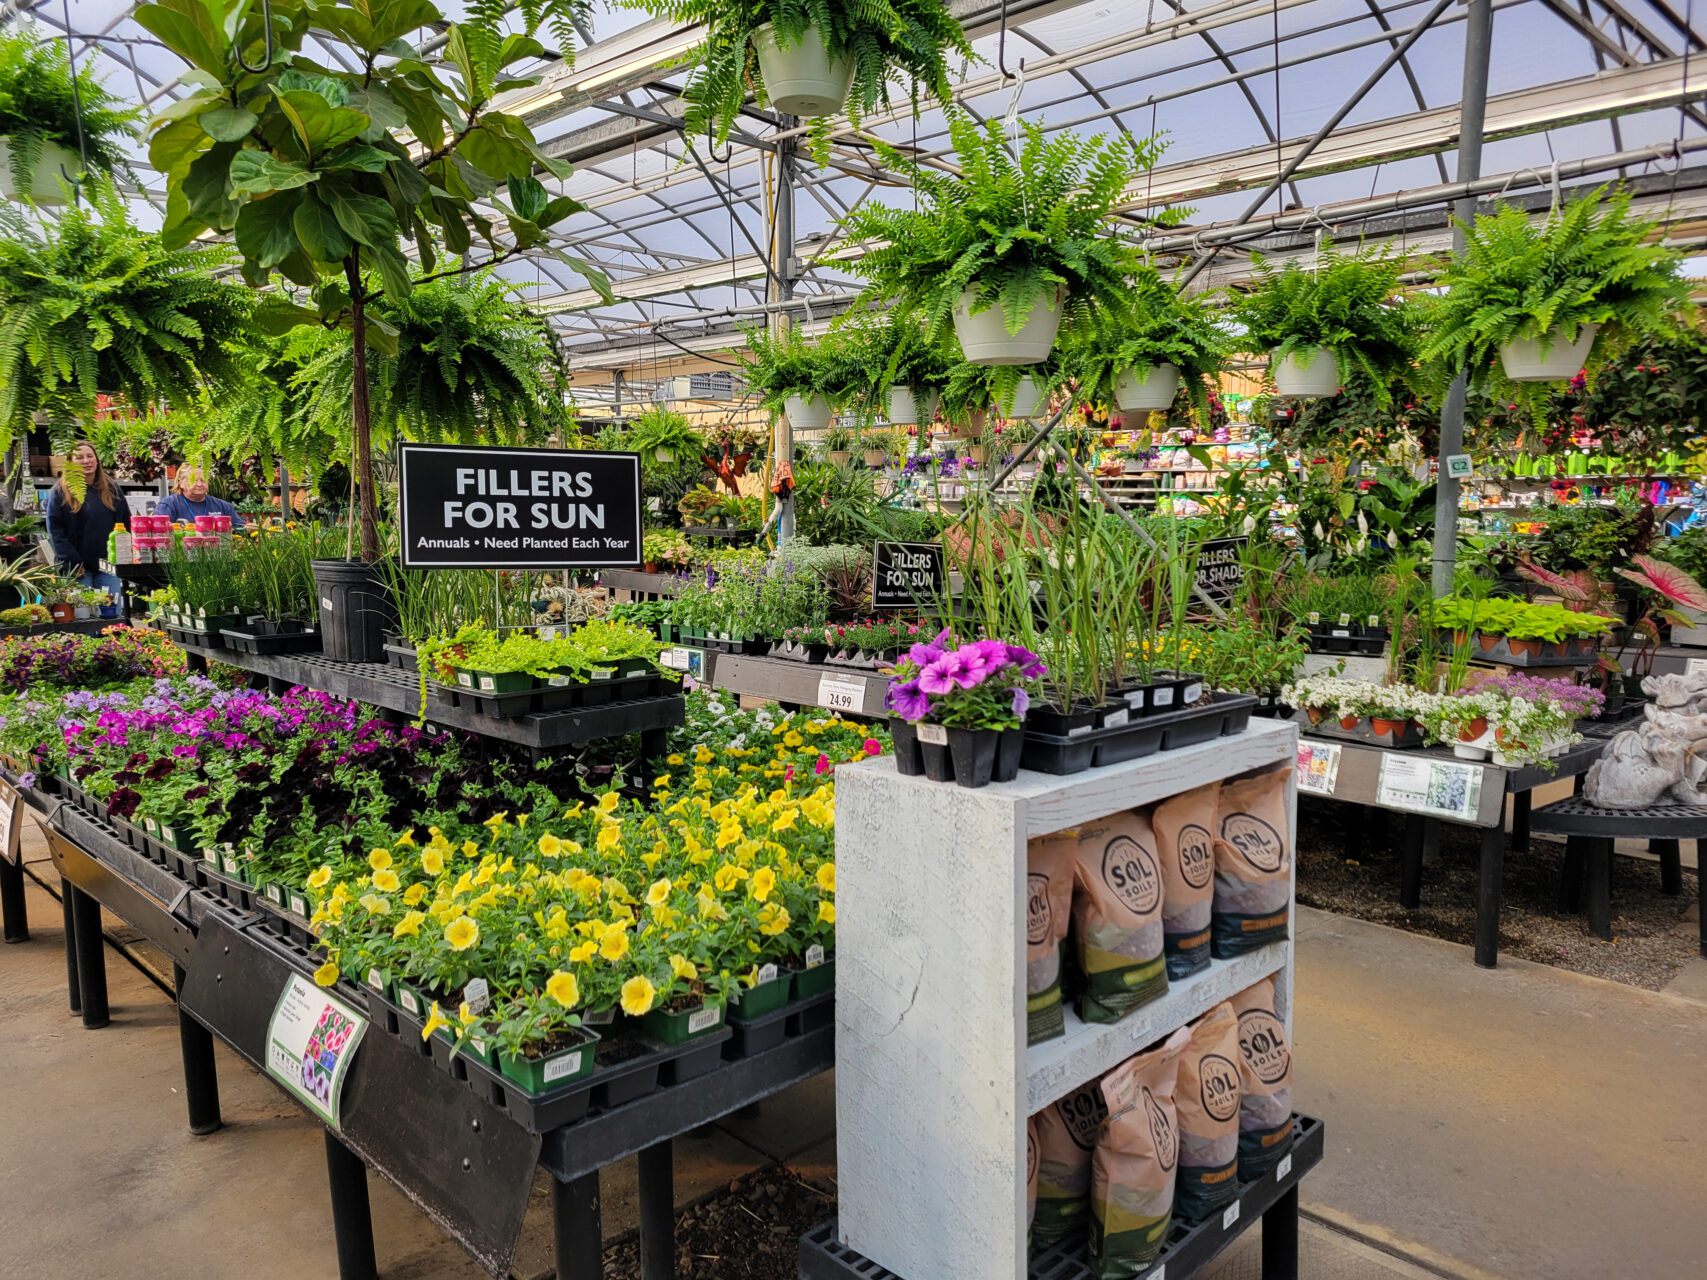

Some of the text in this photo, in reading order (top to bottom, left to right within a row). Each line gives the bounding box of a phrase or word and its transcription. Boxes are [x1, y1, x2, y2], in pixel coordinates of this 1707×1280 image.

[1452, 461, 1469, 471] C2
[456, 468, 593, 498] FILLERS
[444, 501, 605, 529] FOR SUN
[417, 536, 630, 549] Annuals Need Planted Each Year
[892, 553, 931, 568] FILLERS
[1197, 548, 1235, 567] FILLERS
[912, 572, 934, 586] SUN
[829, 693, 852, 708] 24.99
[1232, 830, 1270, 851] SOL
[1181, 842, 1211, 866] SOL
[1111, 857, 1153, 888] SOL
[1125, 881, 1153, 898] SOILS
[1029, 893, 1047, 915] OL
[1240, 1028, 1283, 1059] SOL
[1253, 1050, 1282, 1067] SOILS
[1205, 1072, 1237, 1099] SOL
[1062, 1088, 1108, 1124] SOL
